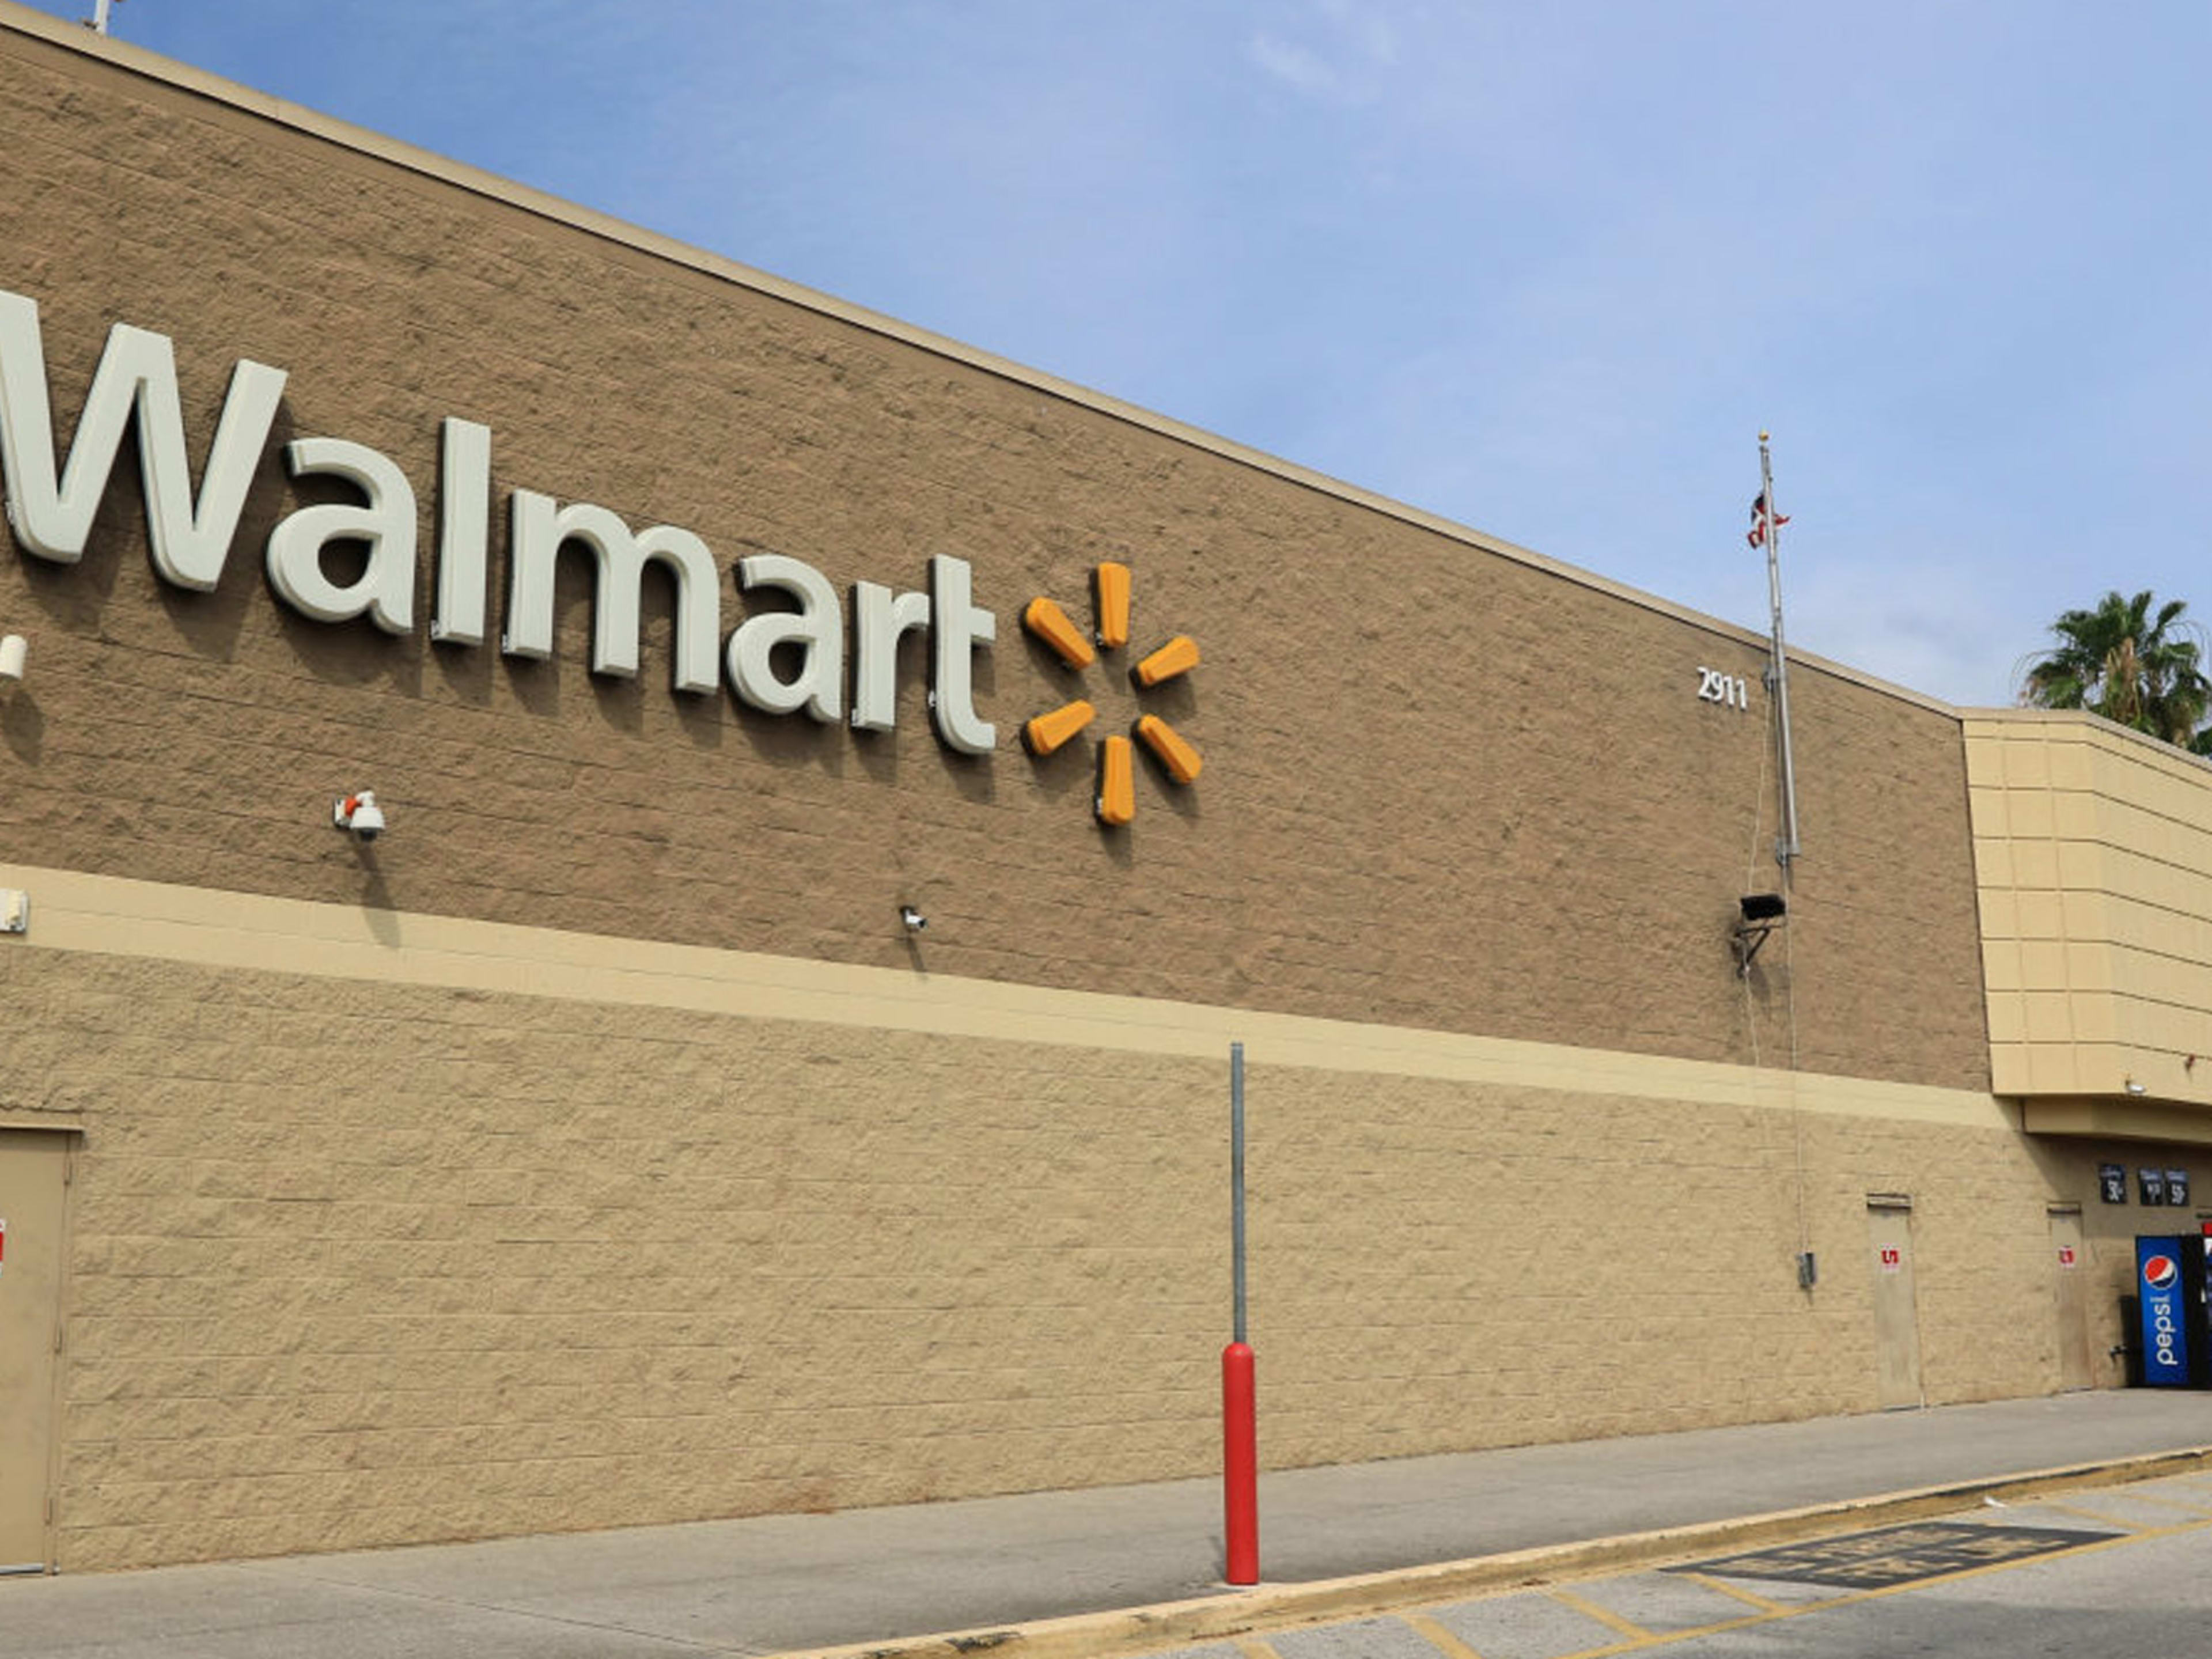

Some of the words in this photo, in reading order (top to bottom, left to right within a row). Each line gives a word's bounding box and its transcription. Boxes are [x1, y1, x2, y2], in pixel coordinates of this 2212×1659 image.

[0, 293, 996, 755] Walmart
[1696, 666, 1747, 709] 2911
[2149, 1294, 2178, 1365] pepsi
